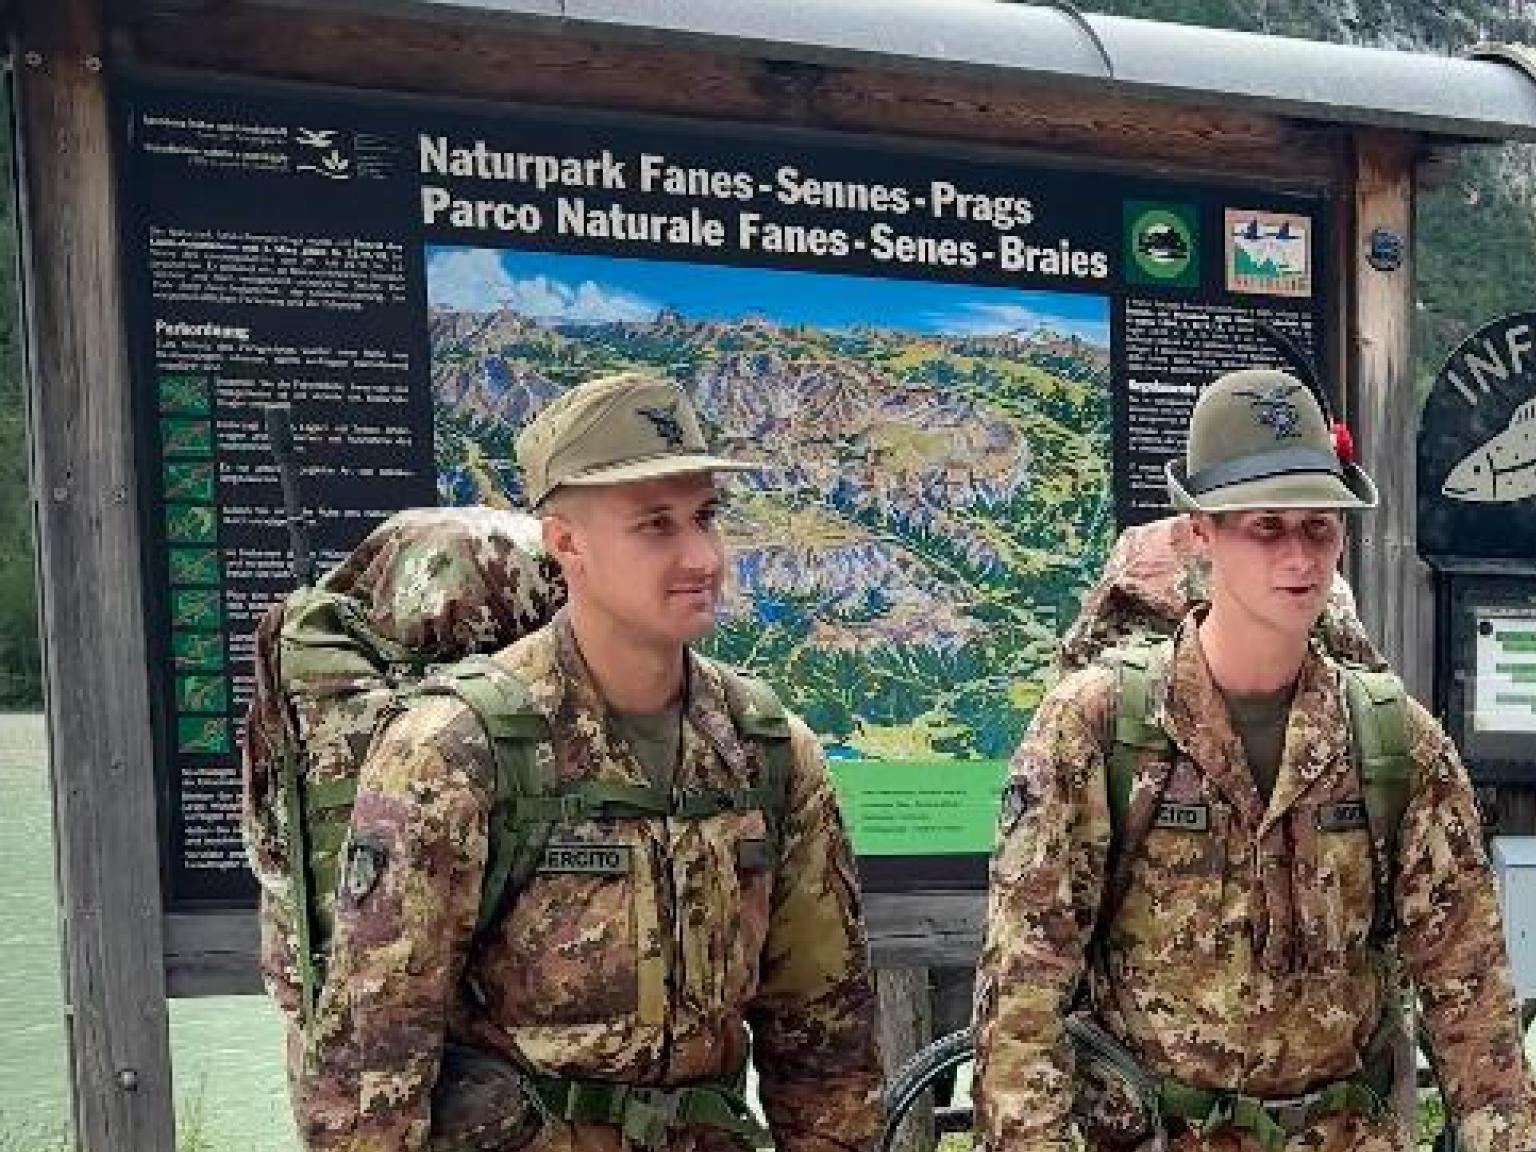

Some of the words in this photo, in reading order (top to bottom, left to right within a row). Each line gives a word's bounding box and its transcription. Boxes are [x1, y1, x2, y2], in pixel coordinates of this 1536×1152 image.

[419, 134, 626, 191] Naturpark
[421, 186, 542, 233] Parco
[557, 198, 726, 247] Naturale
[548, 850, 621, 869] ERCITO
